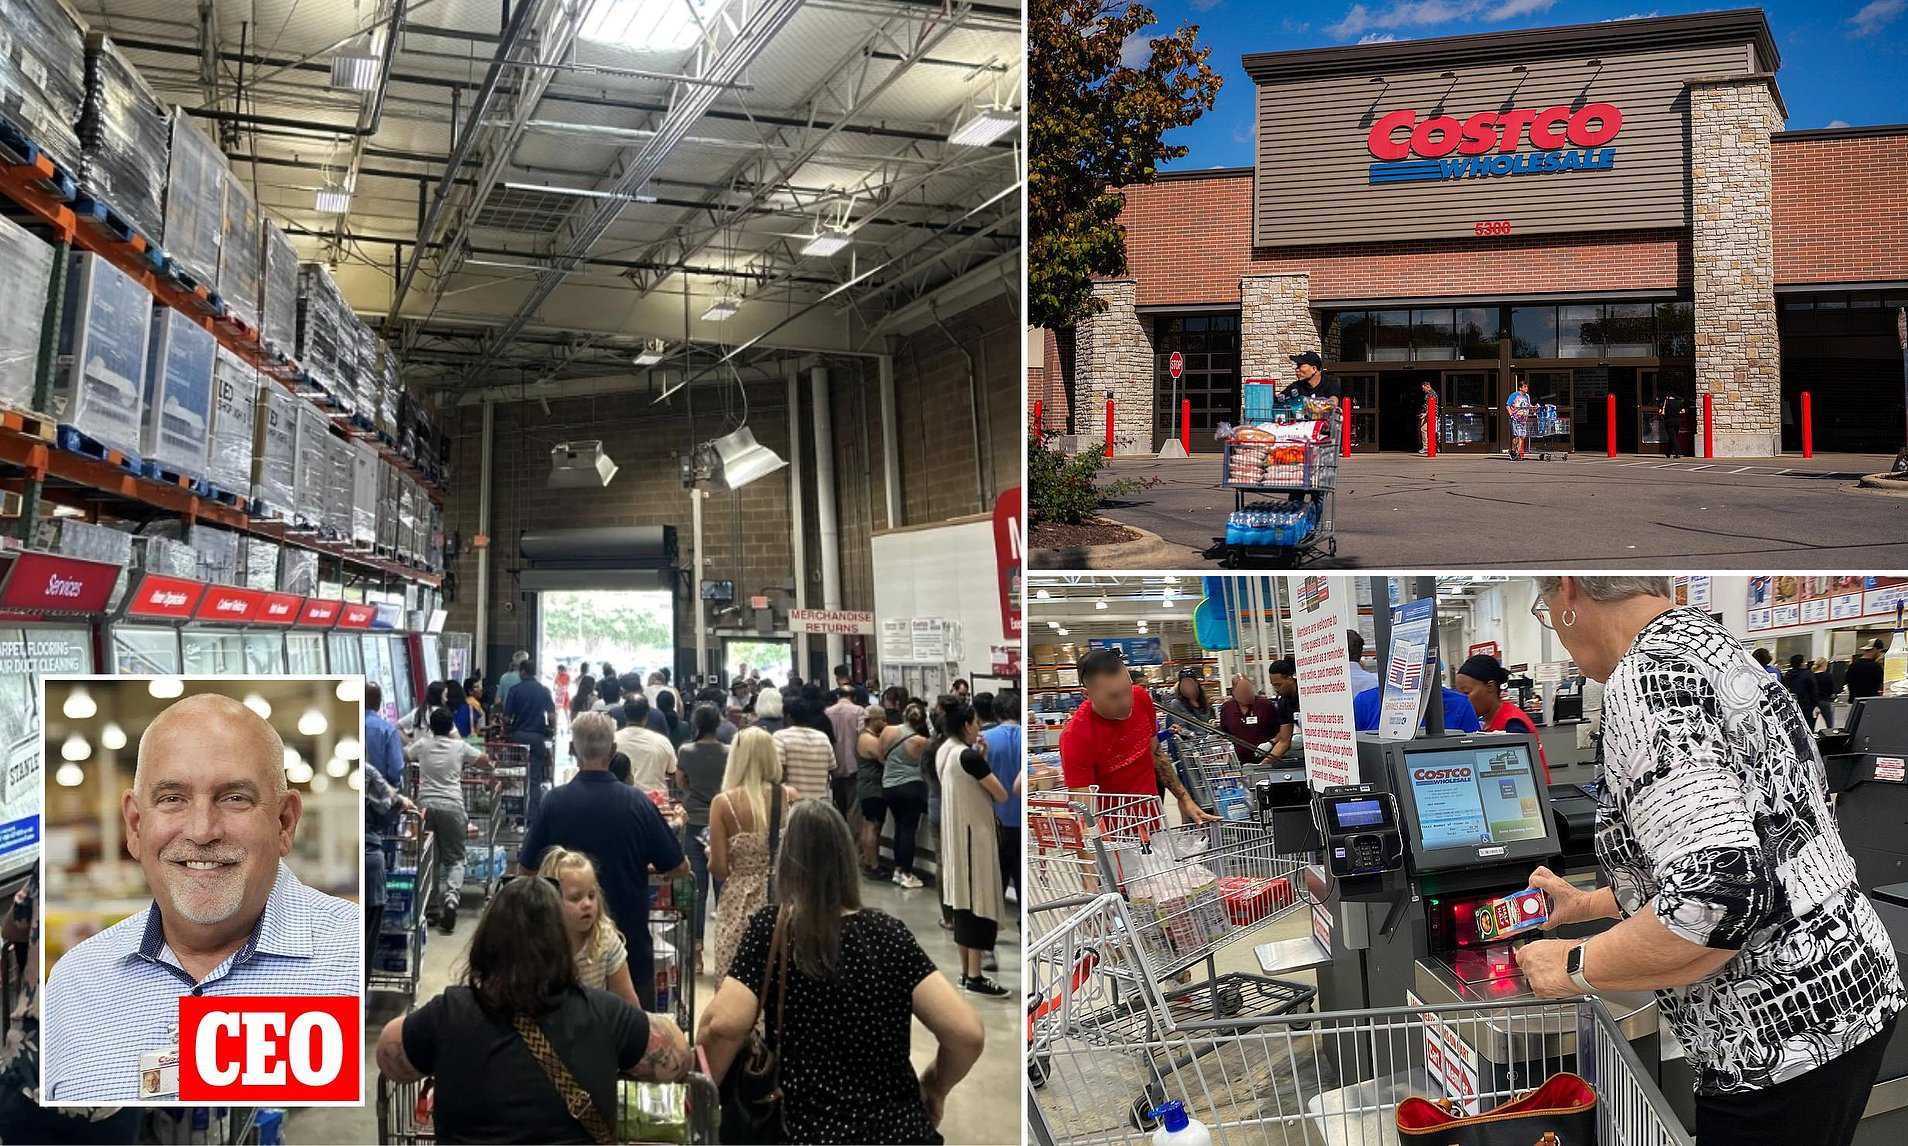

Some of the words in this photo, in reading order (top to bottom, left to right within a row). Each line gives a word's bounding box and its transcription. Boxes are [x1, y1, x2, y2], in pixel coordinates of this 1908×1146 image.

[1368, 103, 1622, 161] COSTCO
[1440, 148, 1616, 180] WHOLESALE
[1475, 222, 1510, 236] 5300
[1170, 360, 1182, 370] STOP
[218, 380, 233, 402] LED
[45, 574, 82, 597] Services
[792, 610, 872, 622] MERCHANDISE
[1317, 618, 1332, 630] welcome
[1333, 615, 1337, 625] to
[806, 623, 858, 633] RETURNS
[28, 642, 69, 656] FLOORING
[14, 658, 37, 672] DUCT
[40, 657, 79, 672] CLEANING
[1326, 665, 1343, 678] members
[1327, 713, 1336, 724] cards
[1333, 729, 1351, 741] purchase
[1332, 745, 1341, 756] your
[1341, 744, 1354, 758] photo
[10, 752, 40, 786] STANLE
[1332, 759, 1343, 770] asked
[1344, 760, 1348, 771] to
[1414, 768, 1472, 780] COSTCO
